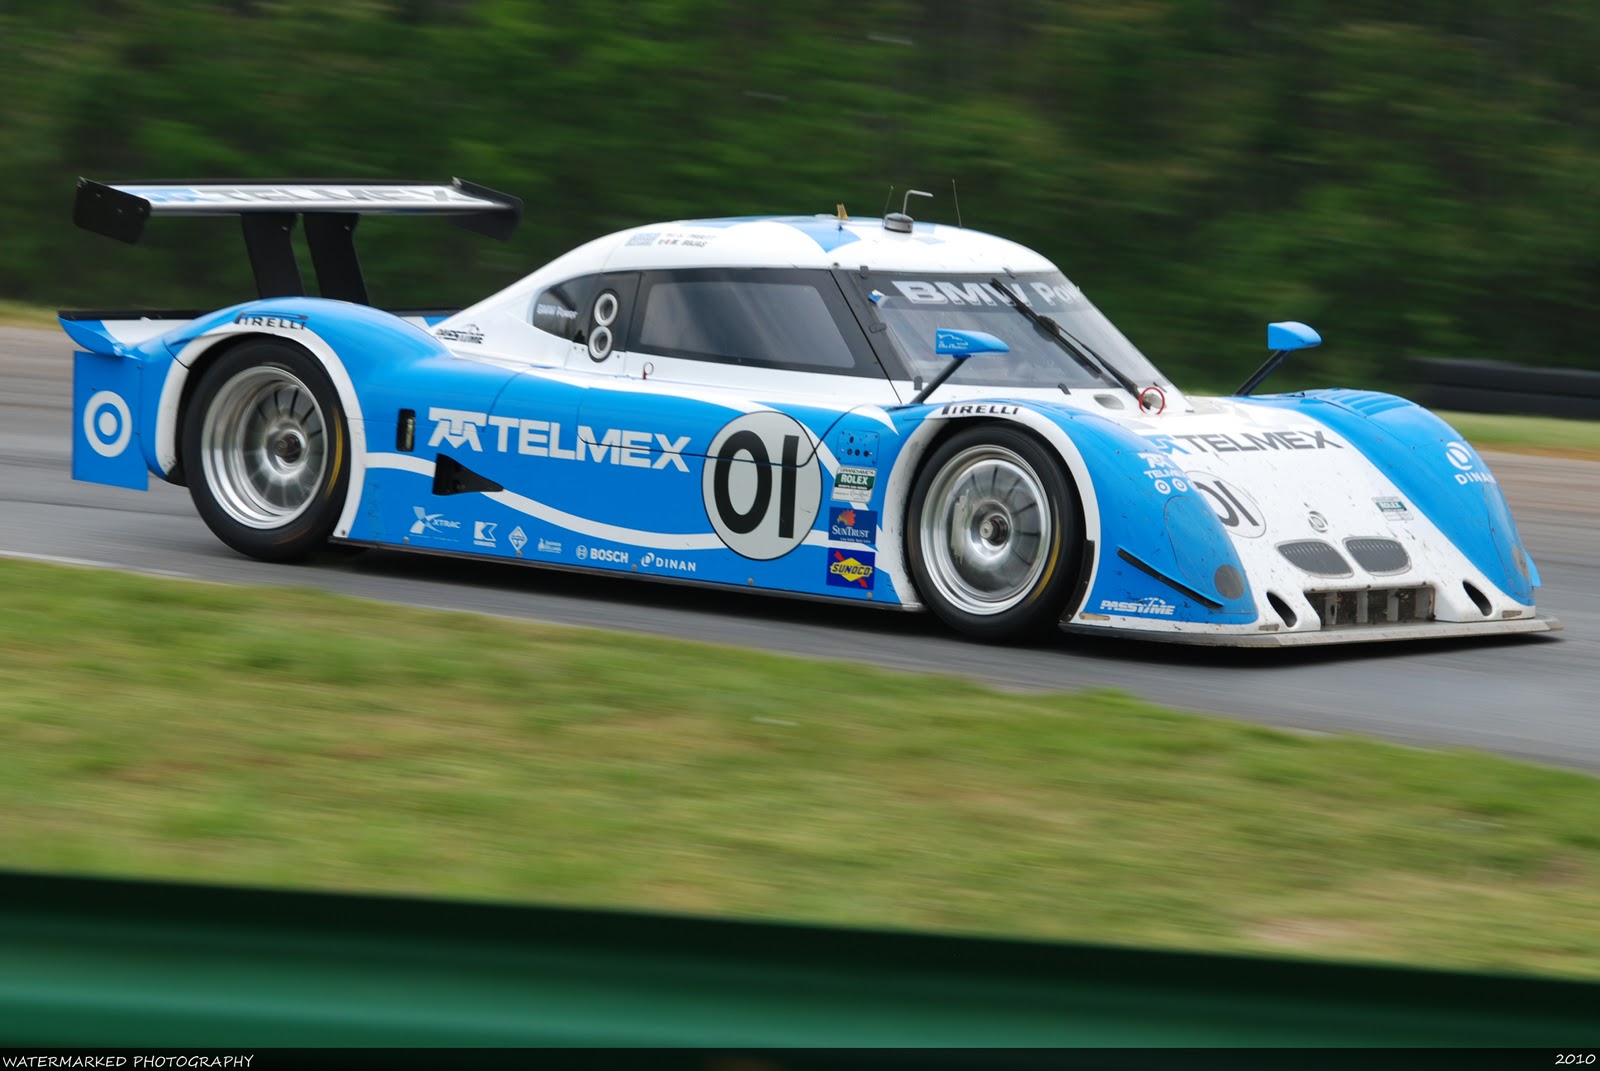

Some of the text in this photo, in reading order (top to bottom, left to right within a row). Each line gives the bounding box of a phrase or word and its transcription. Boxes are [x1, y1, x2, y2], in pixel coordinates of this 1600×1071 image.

[892, 281, 1081, 307] BMW Pow
[235, 311, 308, 330] PIRELLI
[942, 402, 1022, 415] PIRELLI
[488, 415, 692, 473] TELMEX
[1172, 430, 1344, 453] TELMEX
[714, 430, 800, 539] 01
[840, 474, 869, 485] ROLEX
[590, 548, 628, 564] BOSCH
[656, 557, 697, 572] DINAN
[832, 563, 871, 576] SUNOCO
